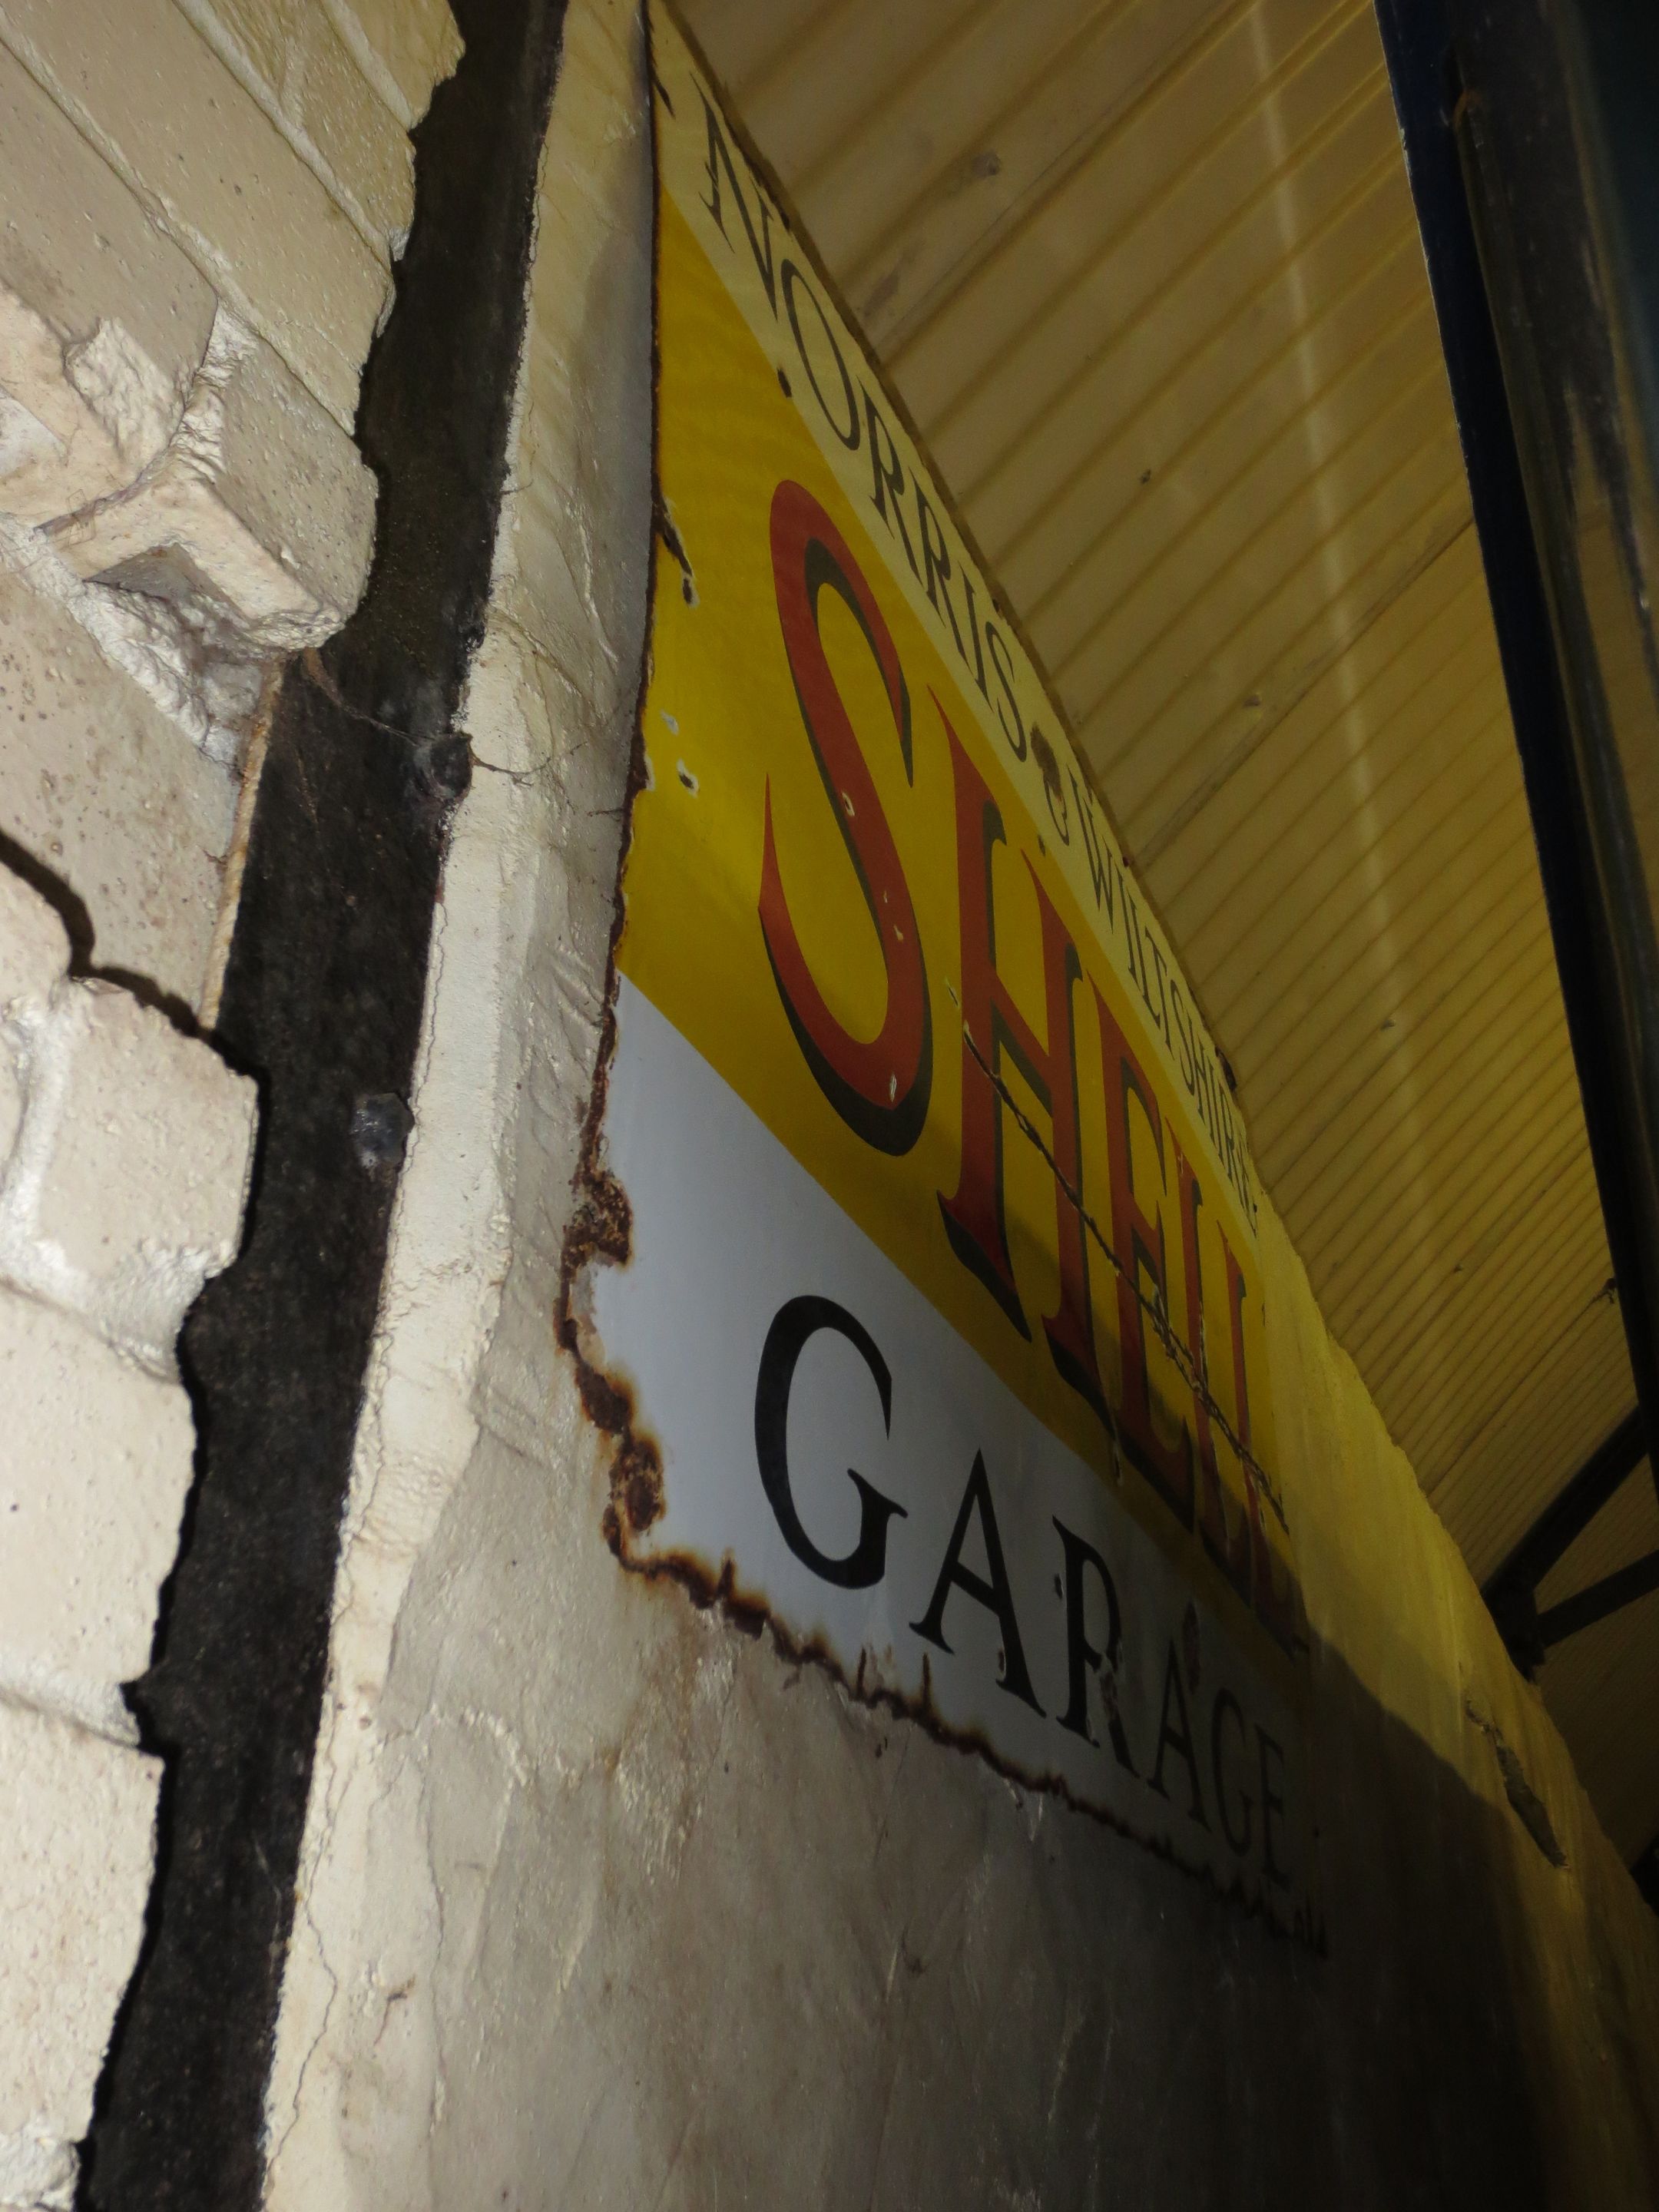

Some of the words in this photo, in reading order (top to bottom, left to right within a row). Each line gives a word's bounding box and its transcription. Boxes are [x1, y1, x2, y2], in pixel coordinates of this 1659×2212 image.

[689, 71, 1027, 763] NORRIS
[1066, 763, 1258, 1239] WILTSHIRE
[759, 479, 1300, 1665] SHELL
[755, 1295, 1290, 1891] GARAGE
